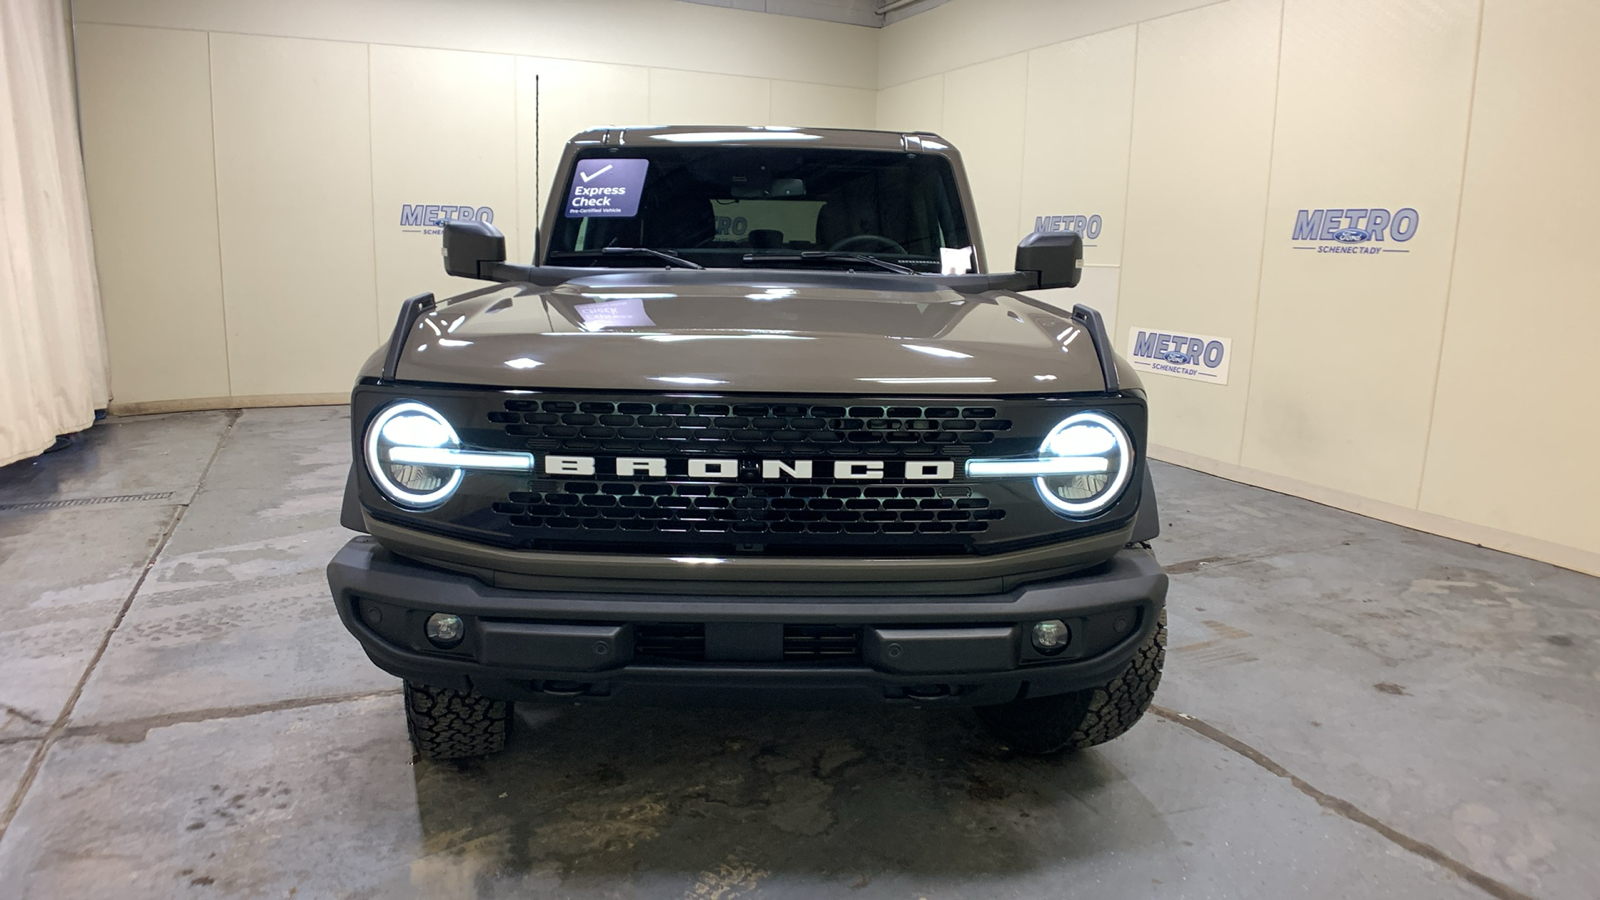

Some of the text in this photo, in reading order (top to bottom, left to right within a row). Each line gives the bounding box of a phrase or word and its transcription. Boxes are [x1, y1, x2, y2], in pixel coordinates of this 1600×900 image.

[571, 196, 612, 207] Check
[574, 186, 627, 197] Express
[400, 204, 494, 227] METRO
[1034, 214, 1103, 240] METRO
[1291, 207, 1420, 242] METRO
[1317, 246, 1382, 255] SCHENECTADY
[1133, 330, 1225, 369] METRO
[1151, 362, 1198, 375] SCHENECTADY
[544, 454, 955, 480] BRONCO
